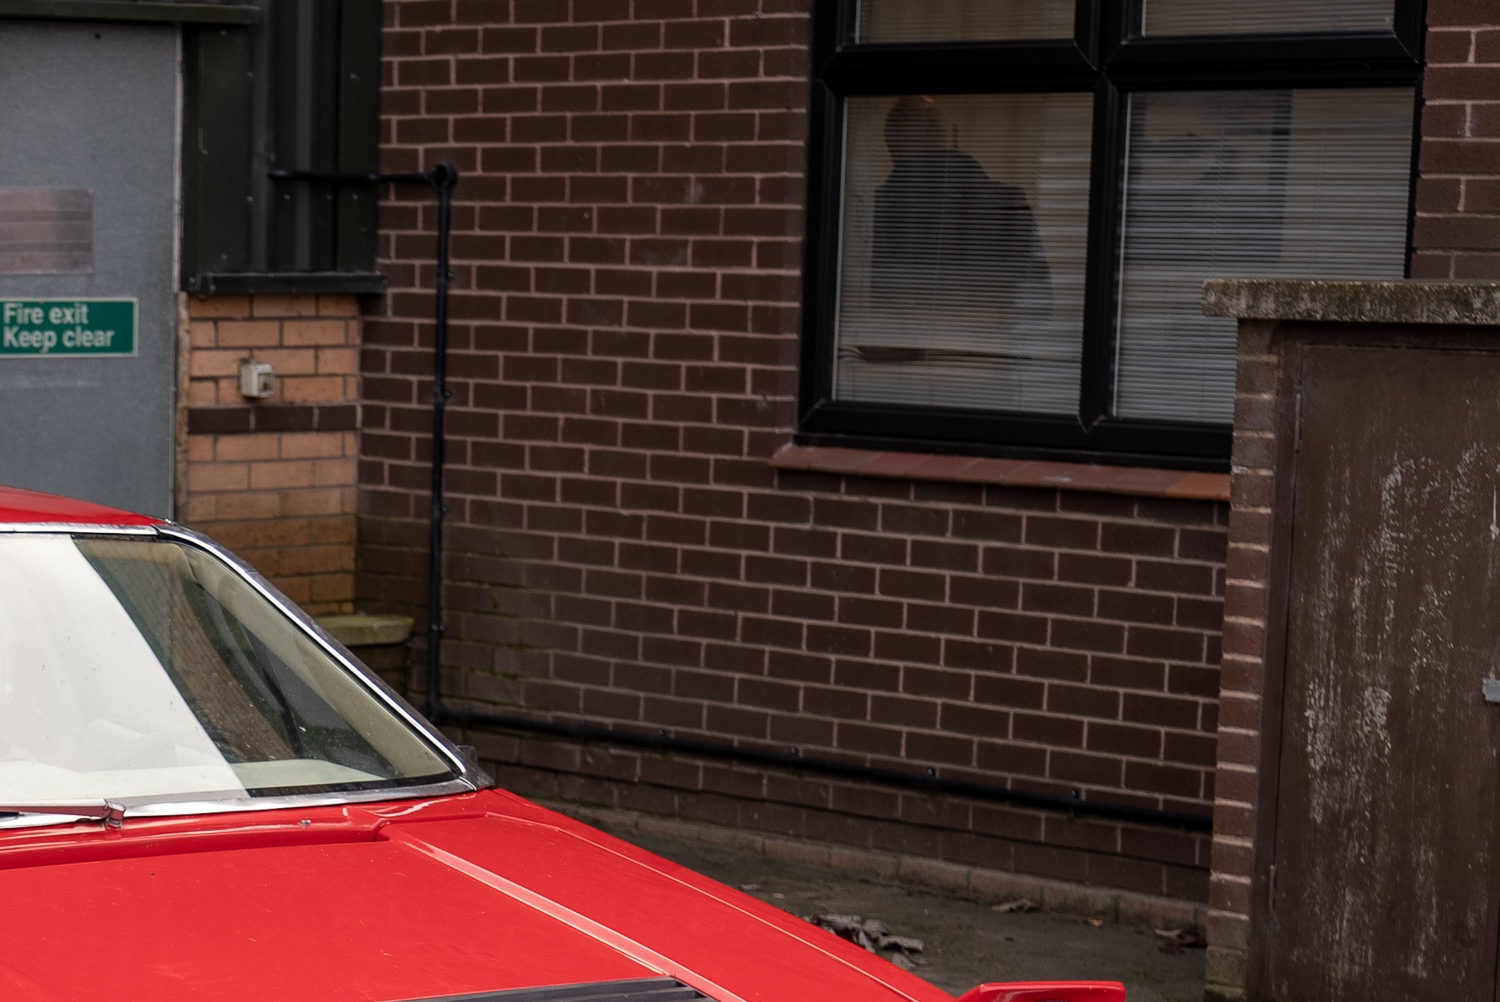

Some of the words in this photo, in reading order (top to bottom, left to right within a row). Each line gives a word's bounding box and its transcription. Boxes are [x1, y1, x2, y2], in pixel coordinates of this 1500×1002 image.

[3, 303, 44, 324] Fire
[49, 303, 88, 324] exit
[3, 326, 57, 353] Keep
[62, 326, 114, 347] clear
